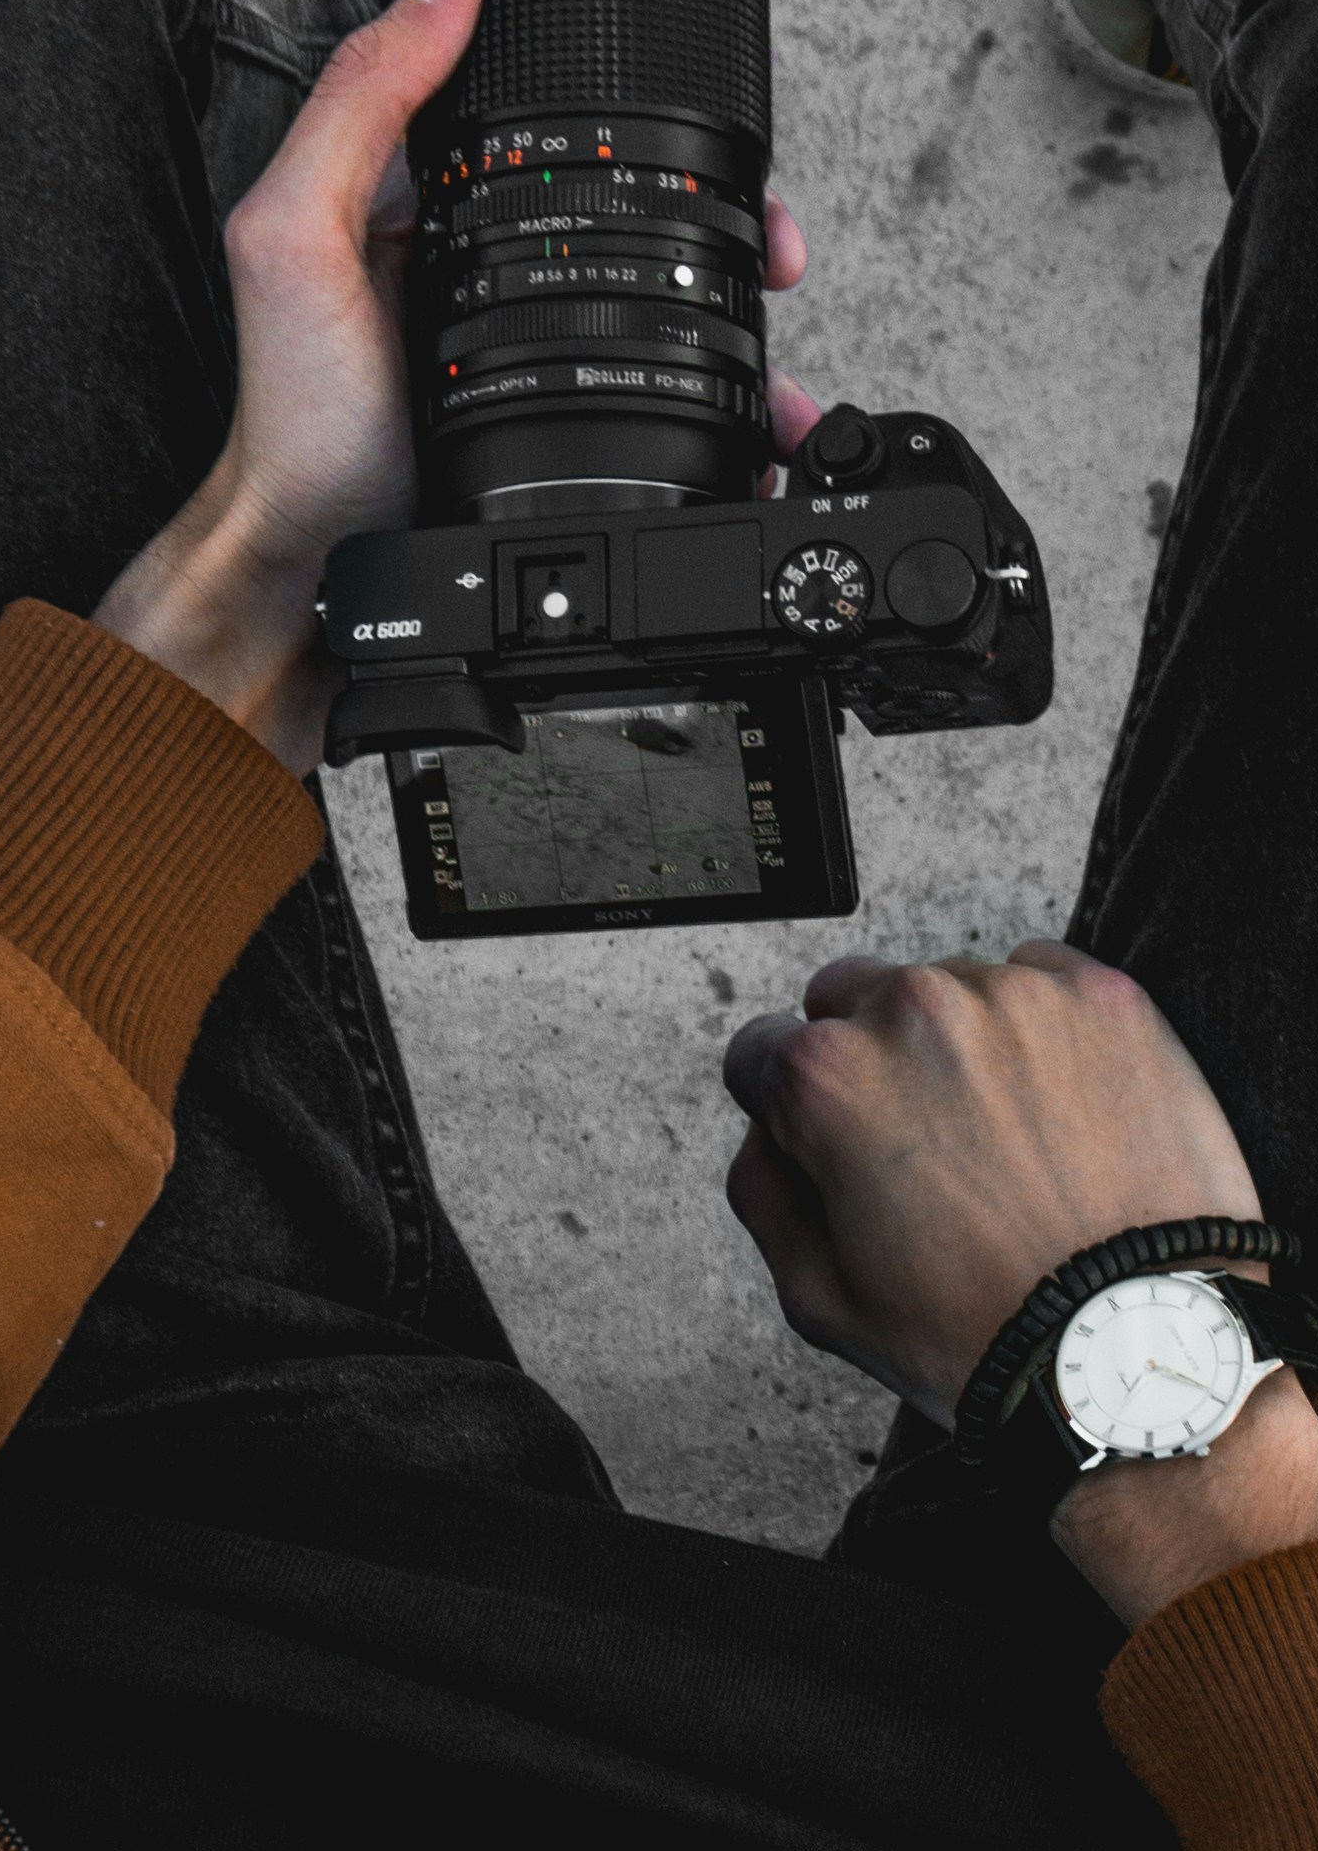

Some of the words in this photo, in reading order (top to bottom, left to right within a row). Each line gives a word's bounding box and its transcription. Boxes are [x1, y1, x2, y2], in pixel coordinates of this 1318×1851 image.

[483, 136, 501, 155] 25
[513, 131, 533, 148] 50
[596, 126, 612, 143] ft
[506, 149, 523, 166] 12
[596, 144, 612, 160] m
[658, 172, 680, 190] 35
[518, 215, 572, 235] MACRO
[604, 267, 619, 281] 16
[620, 267, 638, 282] 22
[499, 375, 538, 393] OPEN
[653, 373, 705, 394] FD-NEX
[910, 434, 931, 451] C1
[811, 498, 832, 514] ON
[843, 494, 871, 511] OFF
[778, 585, 796, 602] M
[784, 605, 802, 622] S
[803, 618, 821, 633] A
[824, 618, 843, 632] P
[593, 908, 654, 924] SONY
